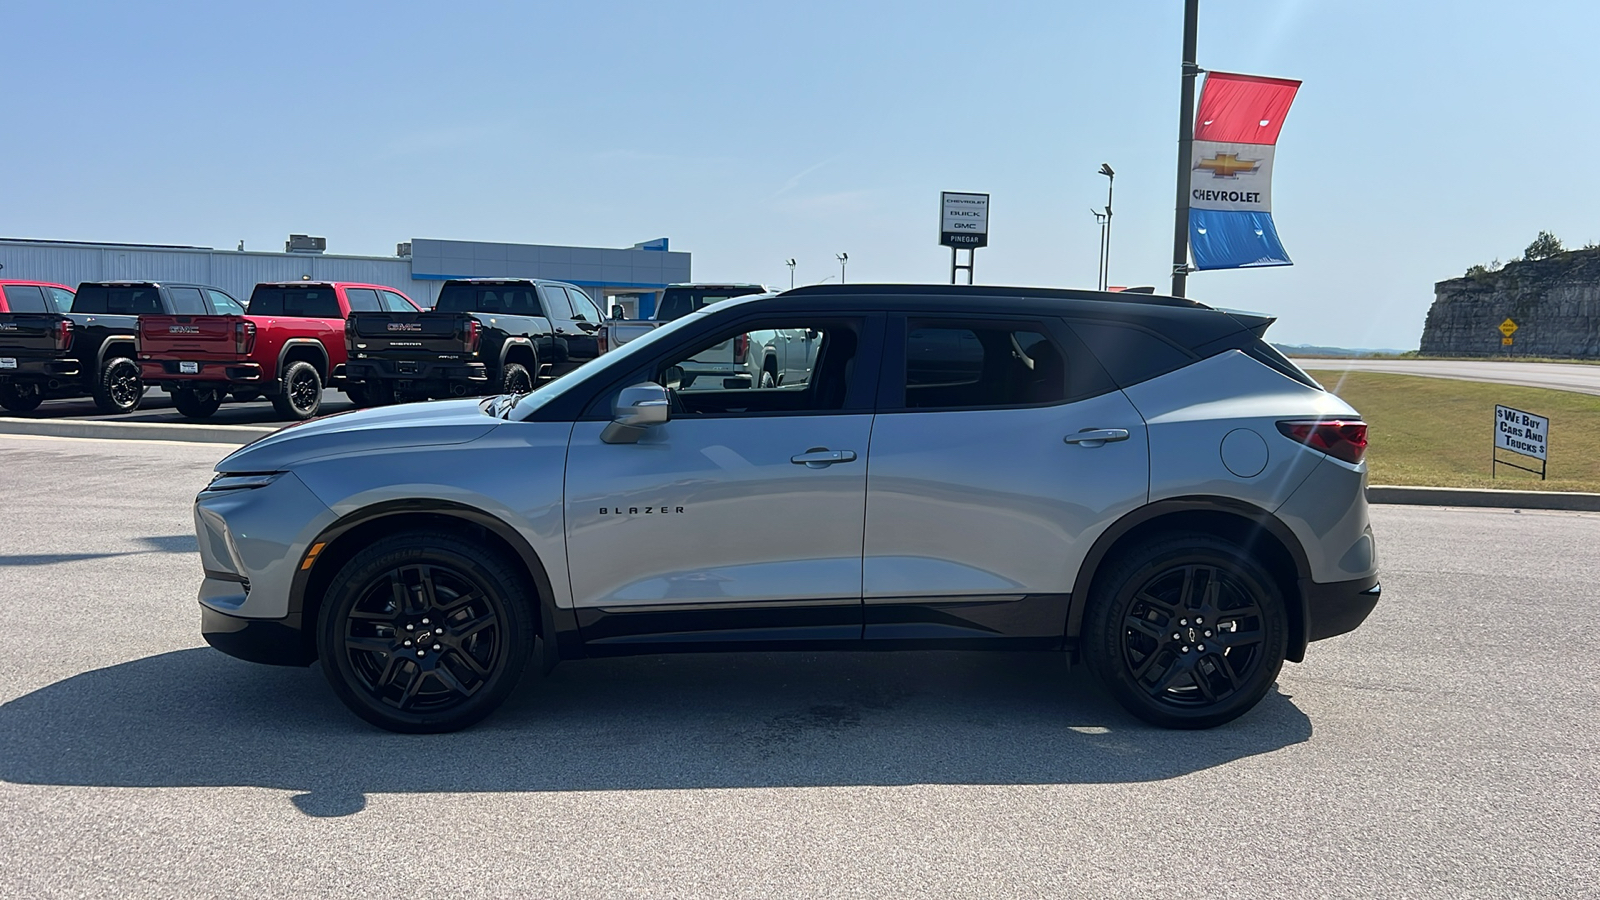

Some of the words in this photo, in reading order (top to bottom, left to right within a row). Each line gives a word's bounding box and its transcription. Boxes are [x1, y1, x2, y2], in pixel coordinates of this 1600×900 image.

[1192, 189, 1260, 203] CHEVROLET
[954, 222, 977, 230] GMC
[950, 235, 979, 243] PINEGAR
[387, 323, 422, 331] GMC
[599, 506, 684, 515] BLAZER
